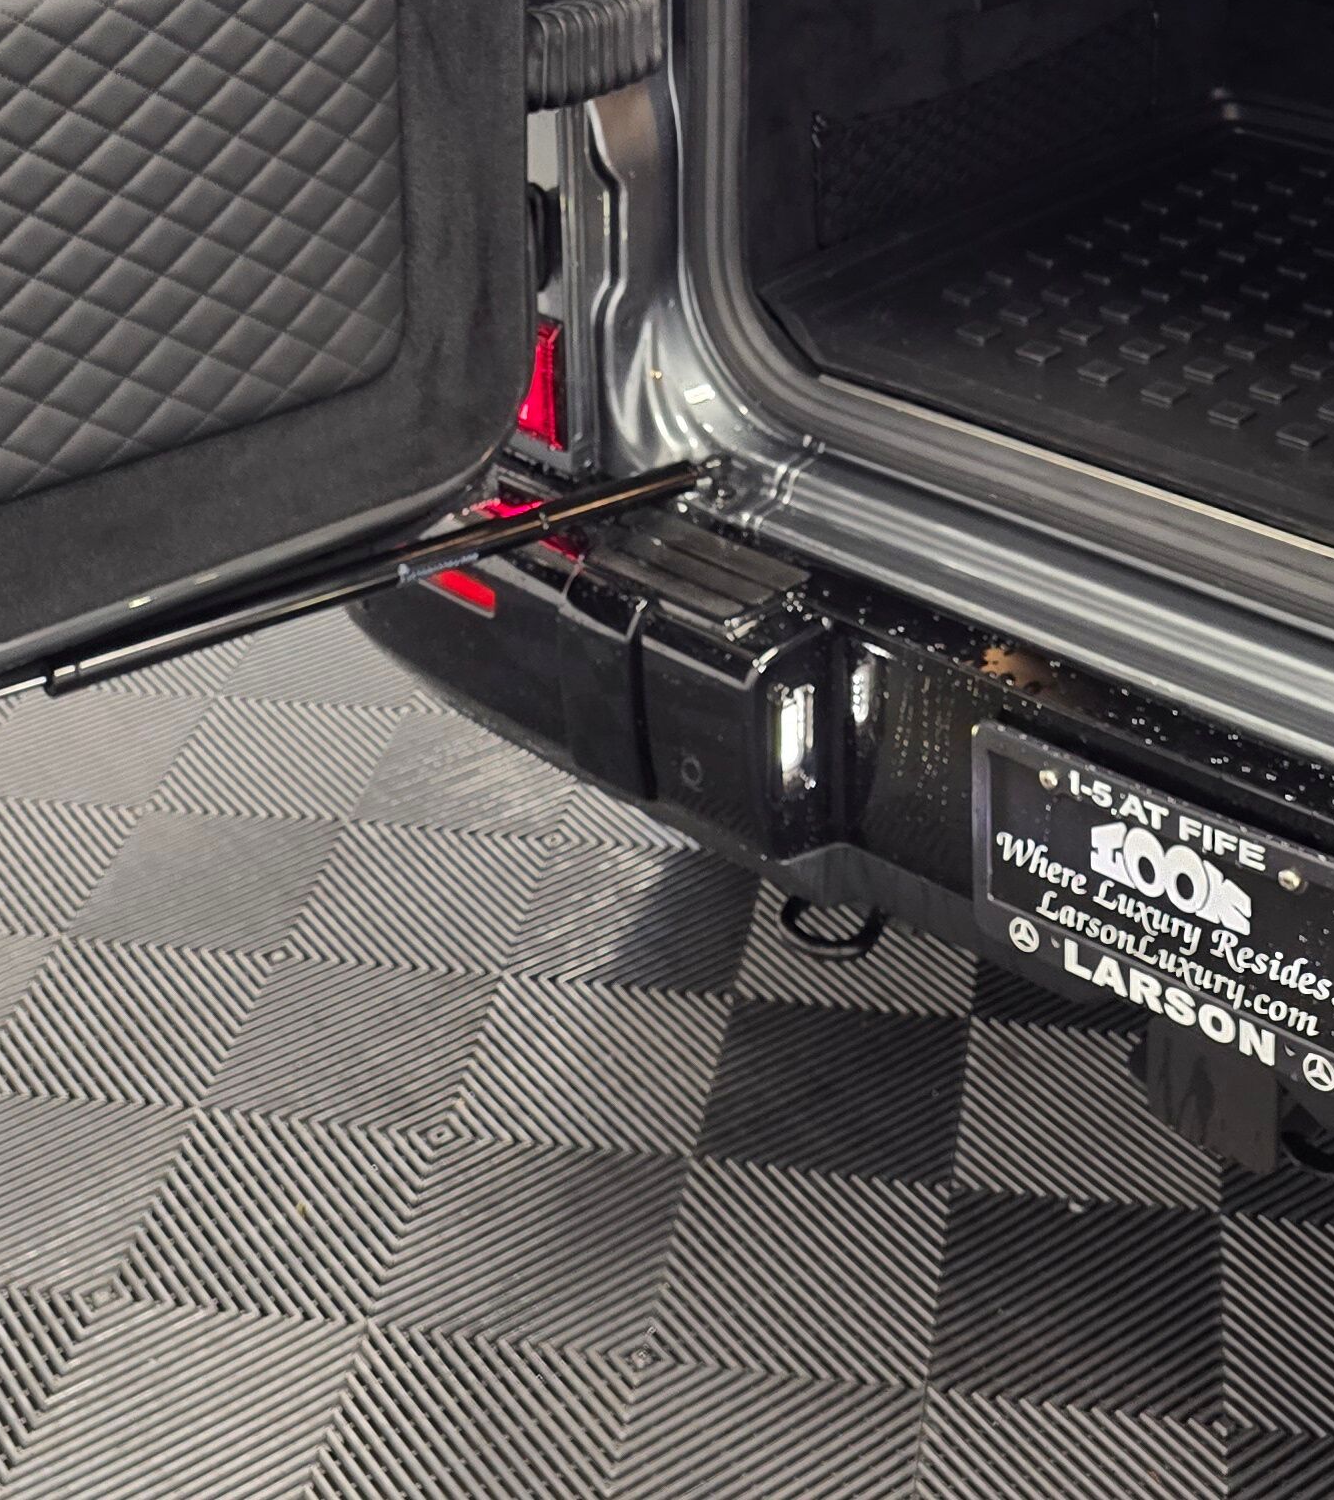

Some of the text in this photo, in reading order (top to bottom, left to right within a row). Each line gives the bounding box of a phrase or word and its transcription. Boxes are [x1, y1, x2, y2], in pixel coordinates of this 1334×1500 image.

[995, 831, 1088, 895] Where
[1092, 878, 1202, 956] Luxury
[1119, 792, 1170, 831] AT
[1178, 815, 1266, 872] FIFE
[1035, 890, 1321, 1037] LarsonLuxury.com
[1064, 937, 1276, 1067] LARSON
